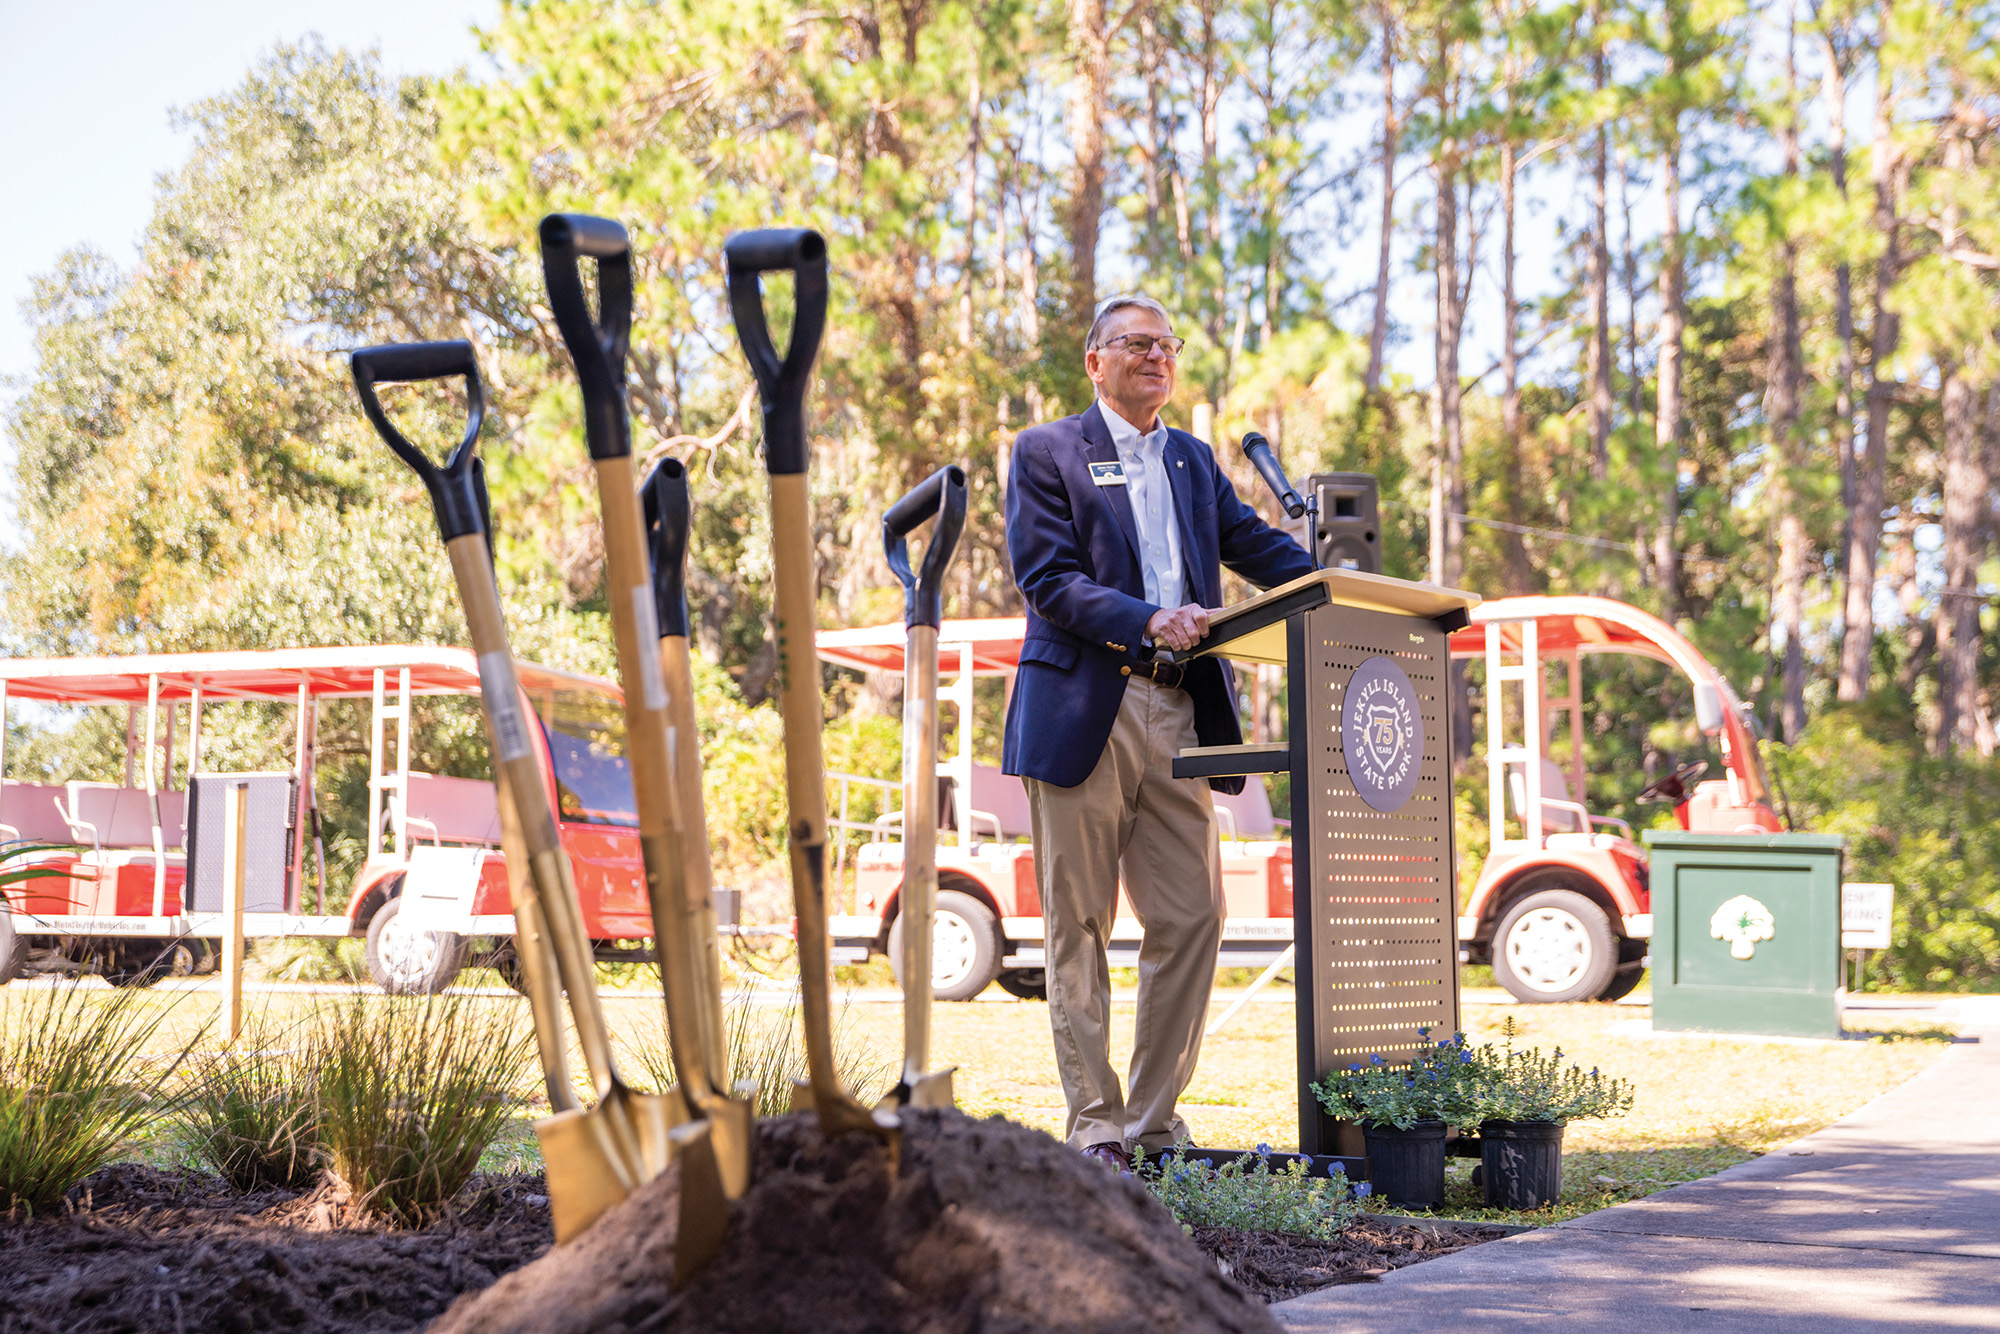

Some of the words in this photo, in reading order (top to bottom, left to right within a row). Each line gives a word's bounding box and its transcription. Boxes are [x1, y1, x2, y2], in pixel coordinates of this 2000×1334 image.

[1353, 679, 1381, 732] JEKYLL
[1383, 679, 1413, 739] ISLAND
[1374, 717, 1394, 745] 75
[1356, 746, 1385, 790] STATE
[1388, 751, 1412, 790] PARK
[1376, 746, 1393, 755] YEARS
